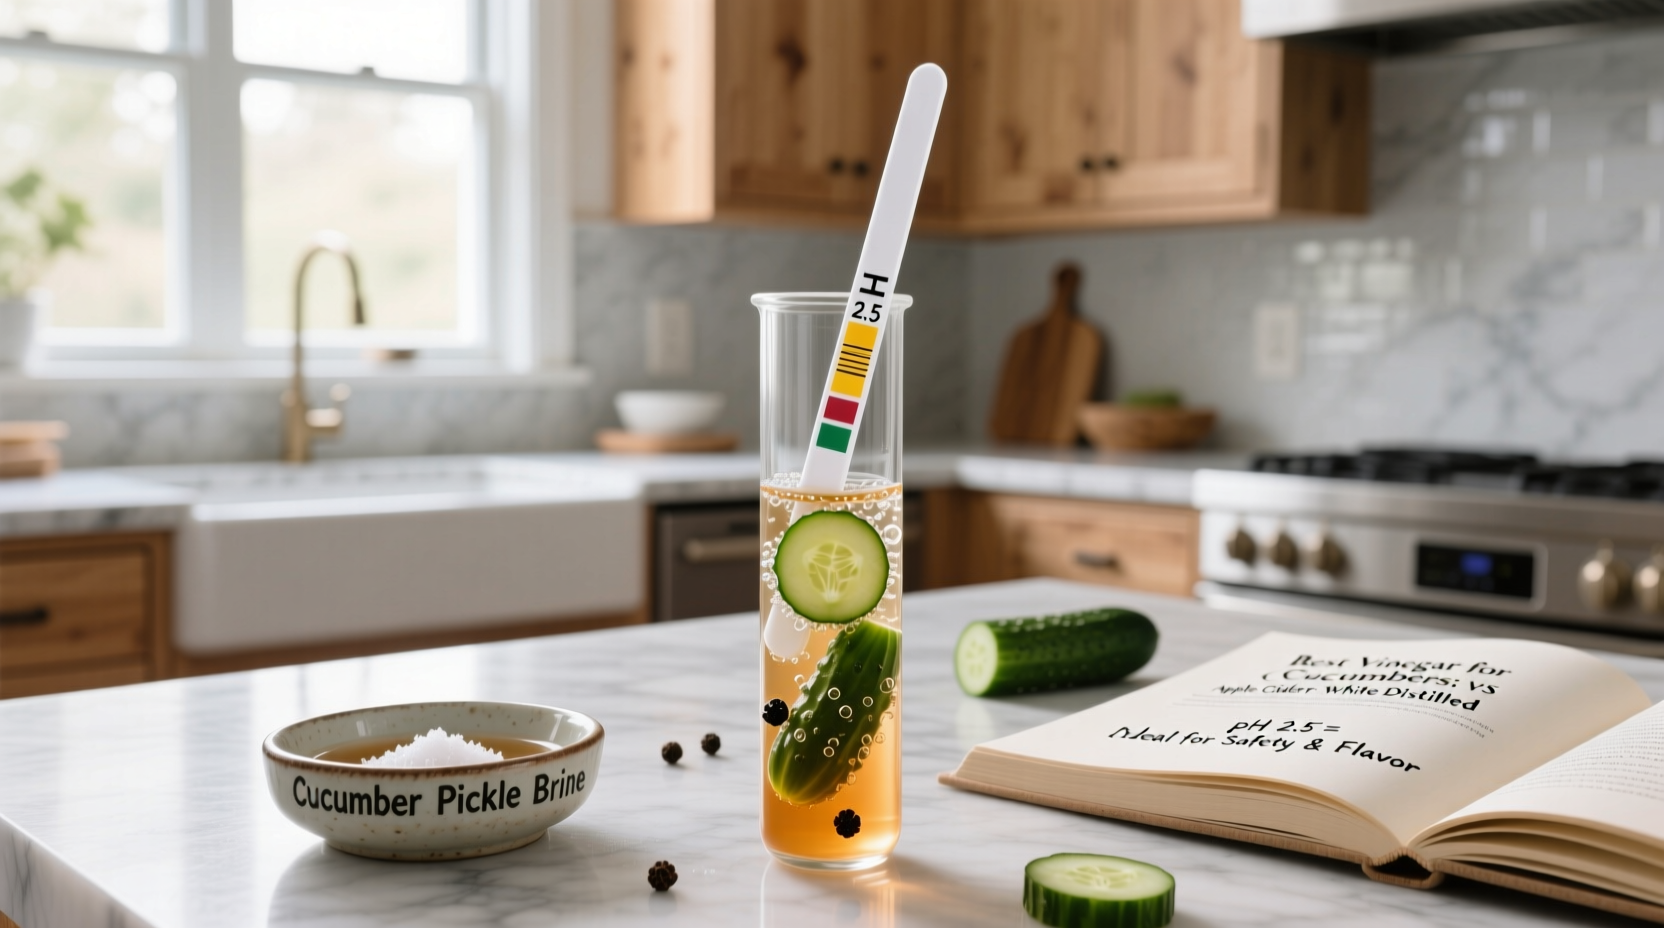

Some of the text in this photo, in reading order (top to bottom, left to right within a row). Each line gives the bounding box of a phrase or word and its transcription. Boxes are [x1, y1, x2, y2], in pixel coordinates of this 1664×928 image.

[851, 301, 883, 322] 2.5
[1362, 656, 1462, 673] Vinegar
[1466, 661, 1512, 676] for
[1326, 685, 1379, 696] White
[1383, 687, 1481, 712] Distilled
[1226, 719, 1273, 734] pH
[1179, 731, 1216, 745] for
[1221, 734, 1296, 753] Safety
[1303, 738, 1324, 751] &
[1334, 740, 1421, 772] Flavor
[292, 768, 587, 817] Cucumber Pickle Brine
